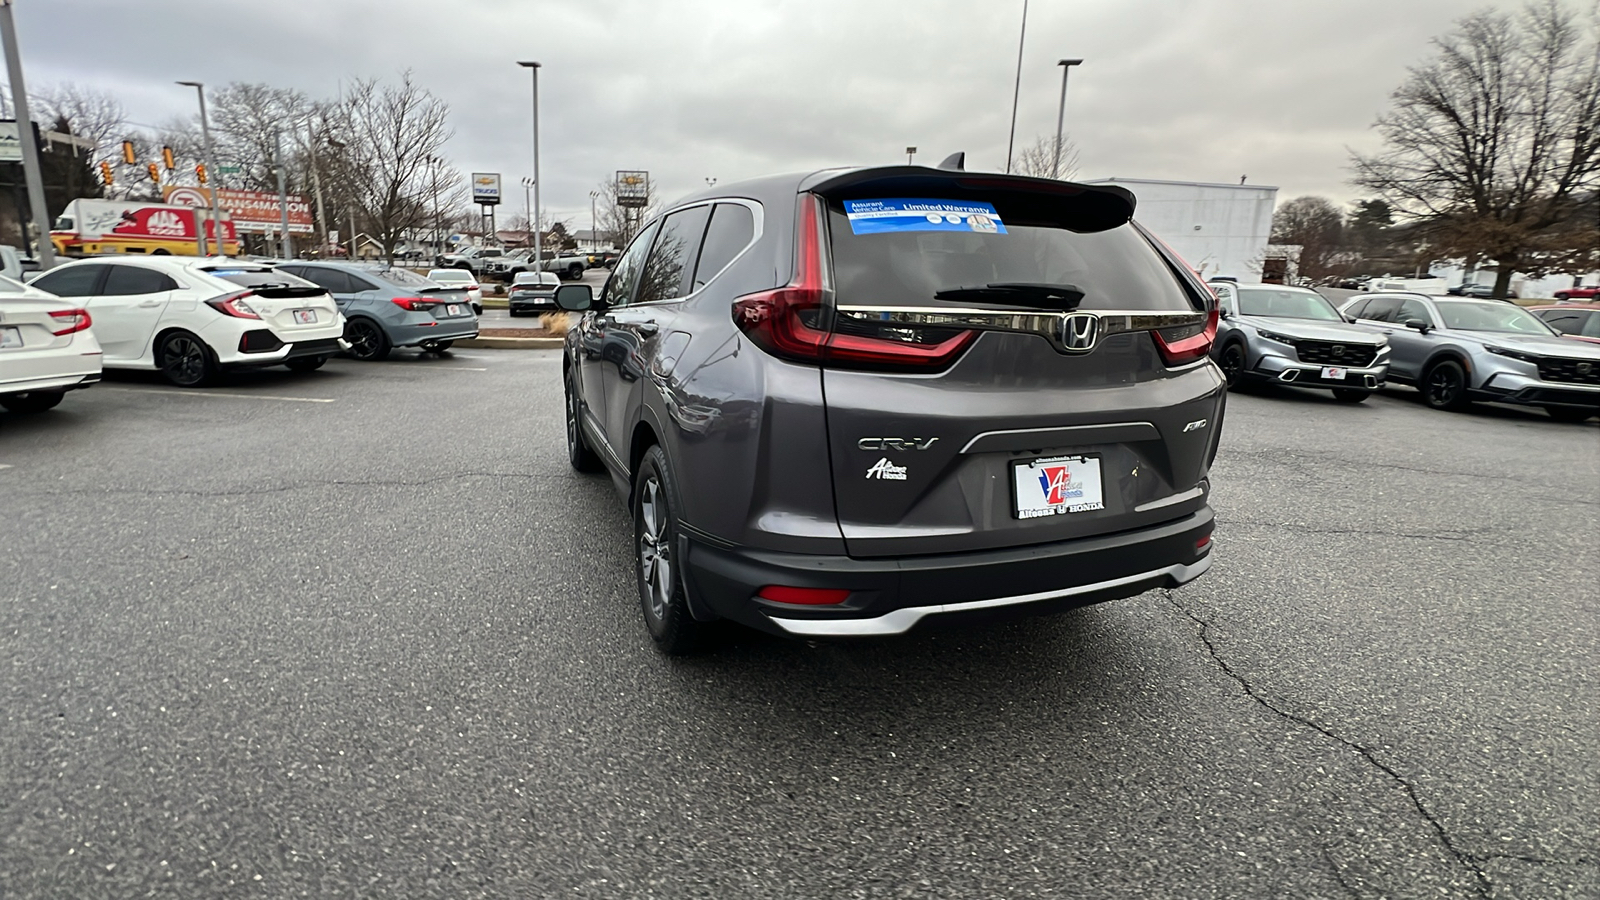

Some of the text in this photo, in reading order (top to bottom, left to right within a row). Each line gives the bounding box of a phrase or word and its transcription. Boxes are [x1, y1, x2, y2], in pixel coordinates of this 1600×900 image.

[903, 203, 989, 214] Limited Warranty
[147, 210, 185, 229] MAC
[148, 228, 186, 236] TOOLS
[1182, 419, 1207, 433] AWD
[858, 437, 939, 451] CR-V
[1018, 502, 1105, 519] Altoona HONDA
